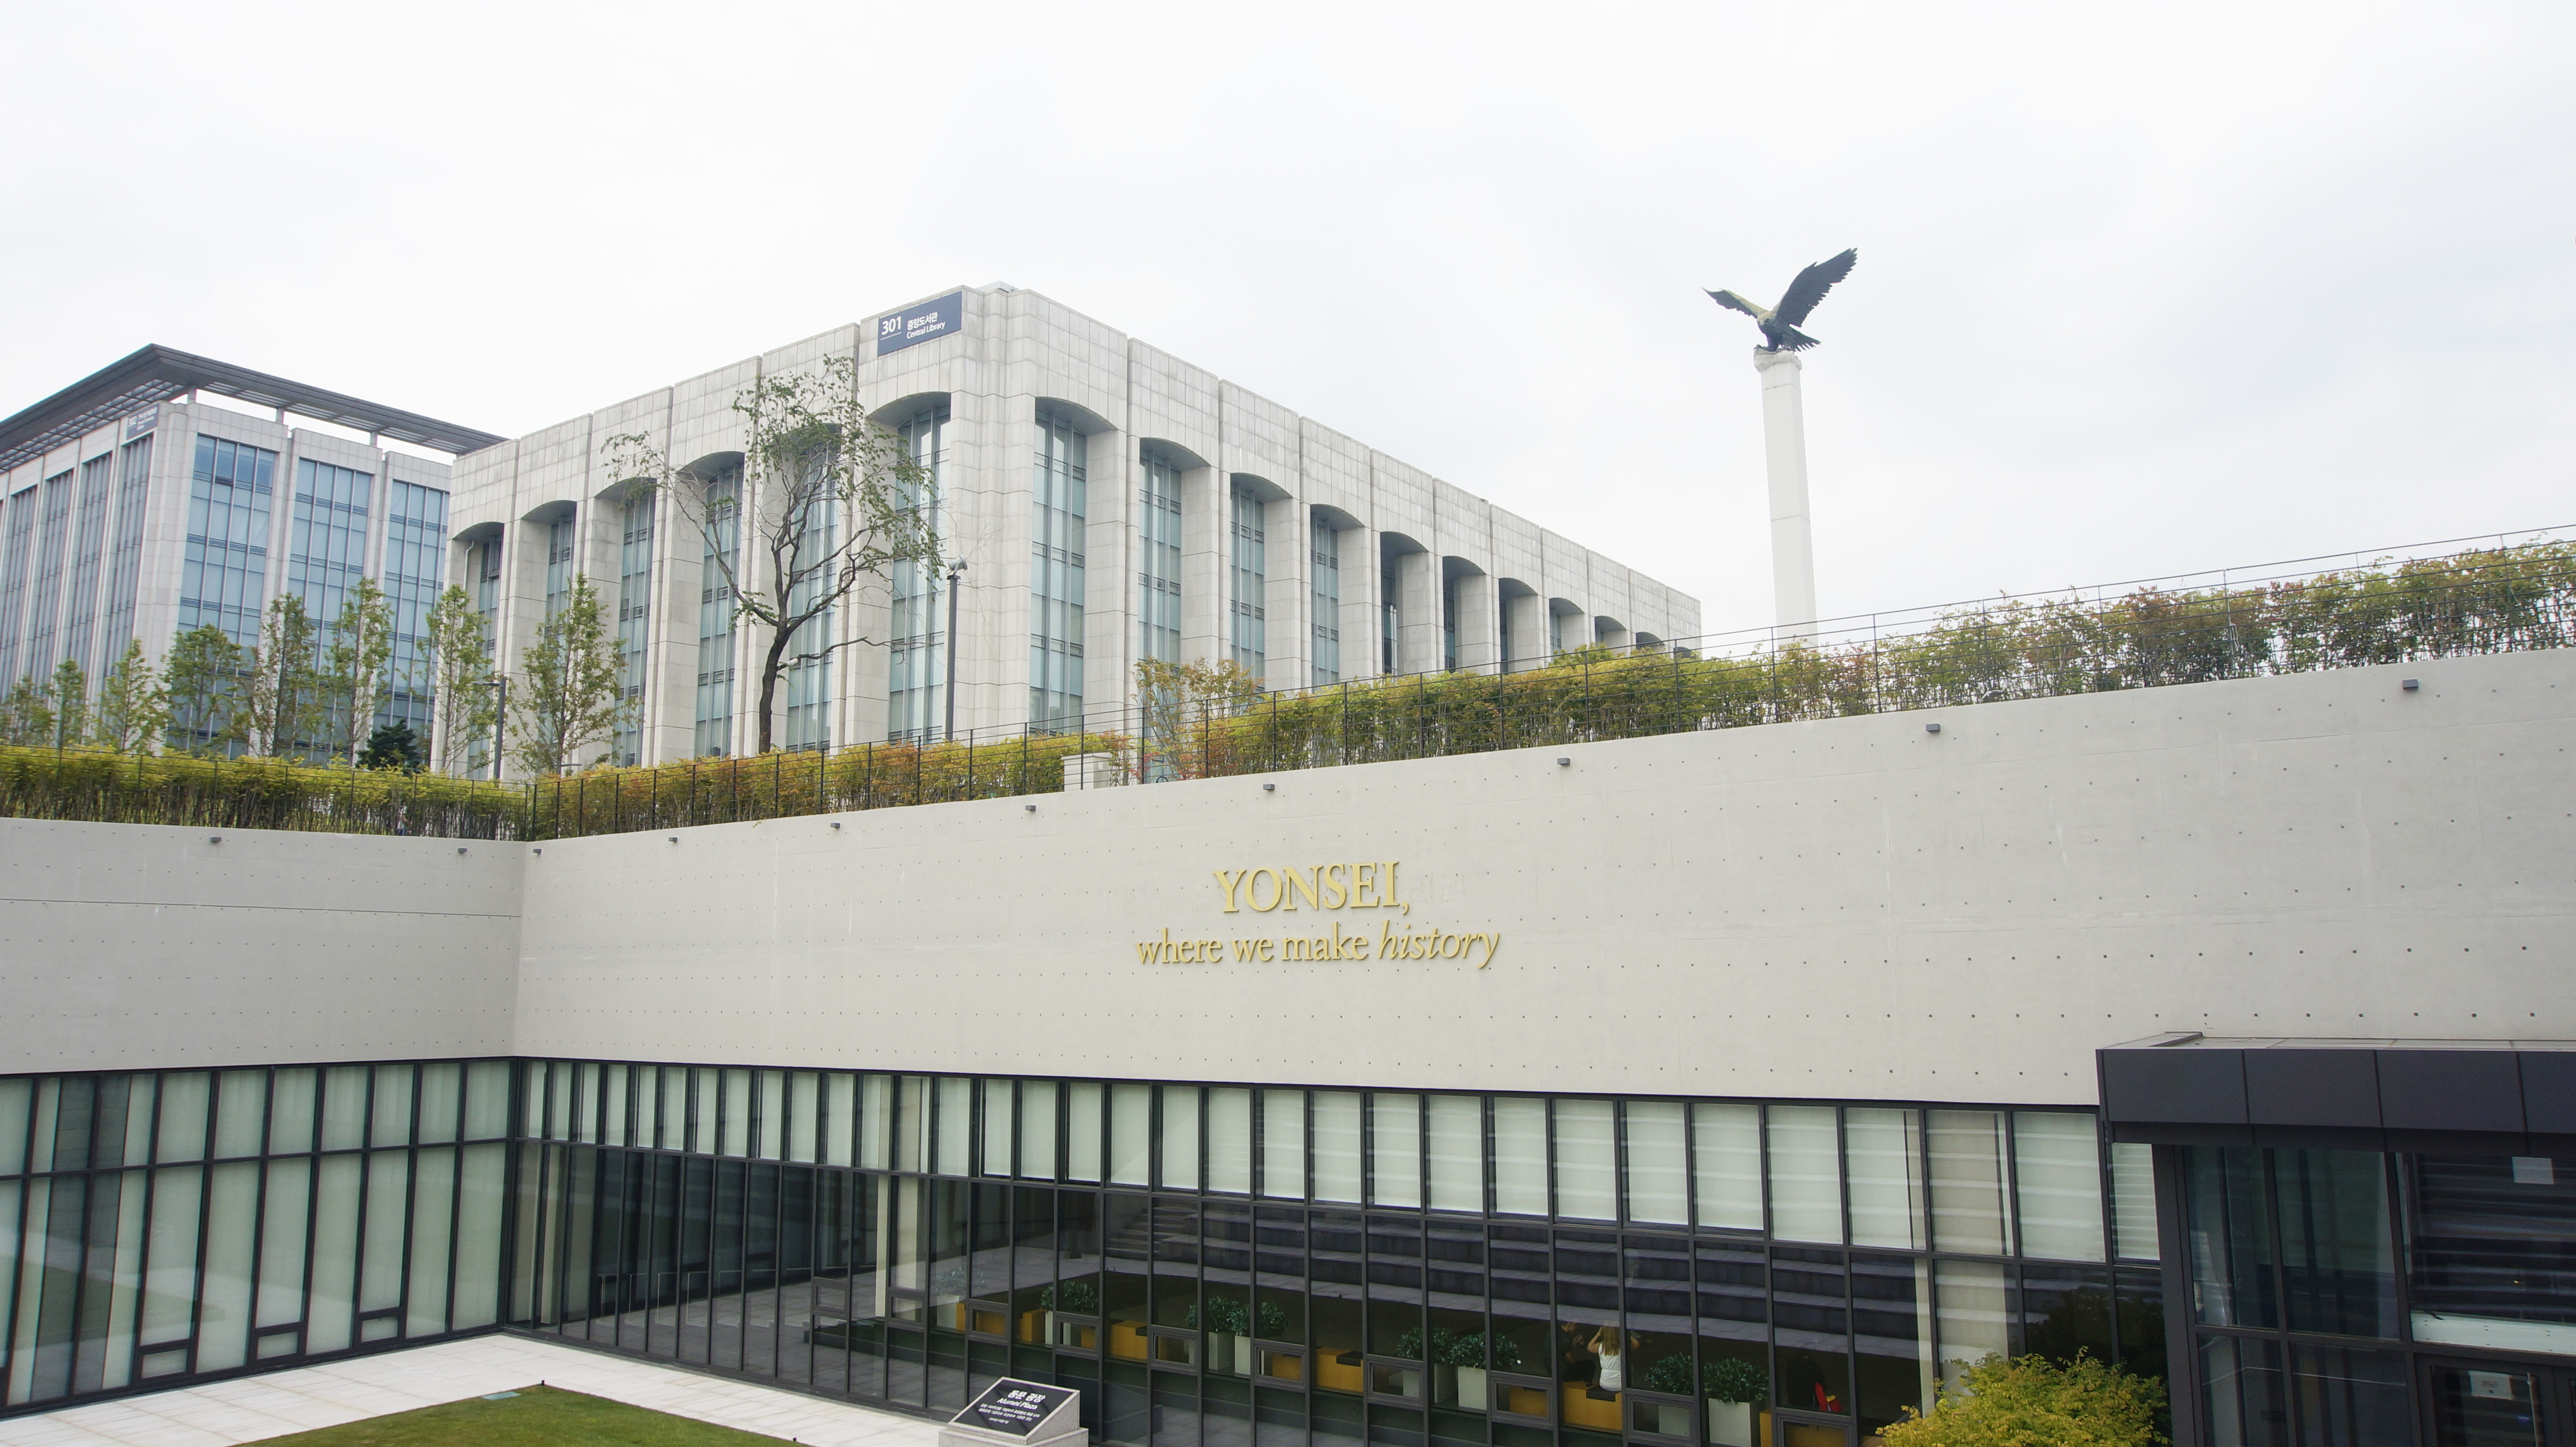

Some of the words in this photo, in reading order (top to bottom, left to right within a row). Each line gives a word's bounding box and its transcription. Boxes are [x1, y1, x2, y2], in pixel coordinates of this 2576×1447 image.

[881, 316, 901, 335] 301
[906, 327, 926, 339] Central
[926, 321, 946, 333] Library
[907, 311, 938, 330] 중앙도서관
[1212, 861, 1410, 914] YONSEI,
[1135, 927, 1223, 965] where
[1231, 940, 1274, 963] we
[1282, 922, 1369, 961] make
[1377, 920, 1500, 969] history
[996, 1398, 1022, 1407] Alumni
[1019, 1401, 1038, 1410] Plaza
[1007, 1390, 1027, 1399] 동문
[1025, 1393, 1046, 1403] 광장
